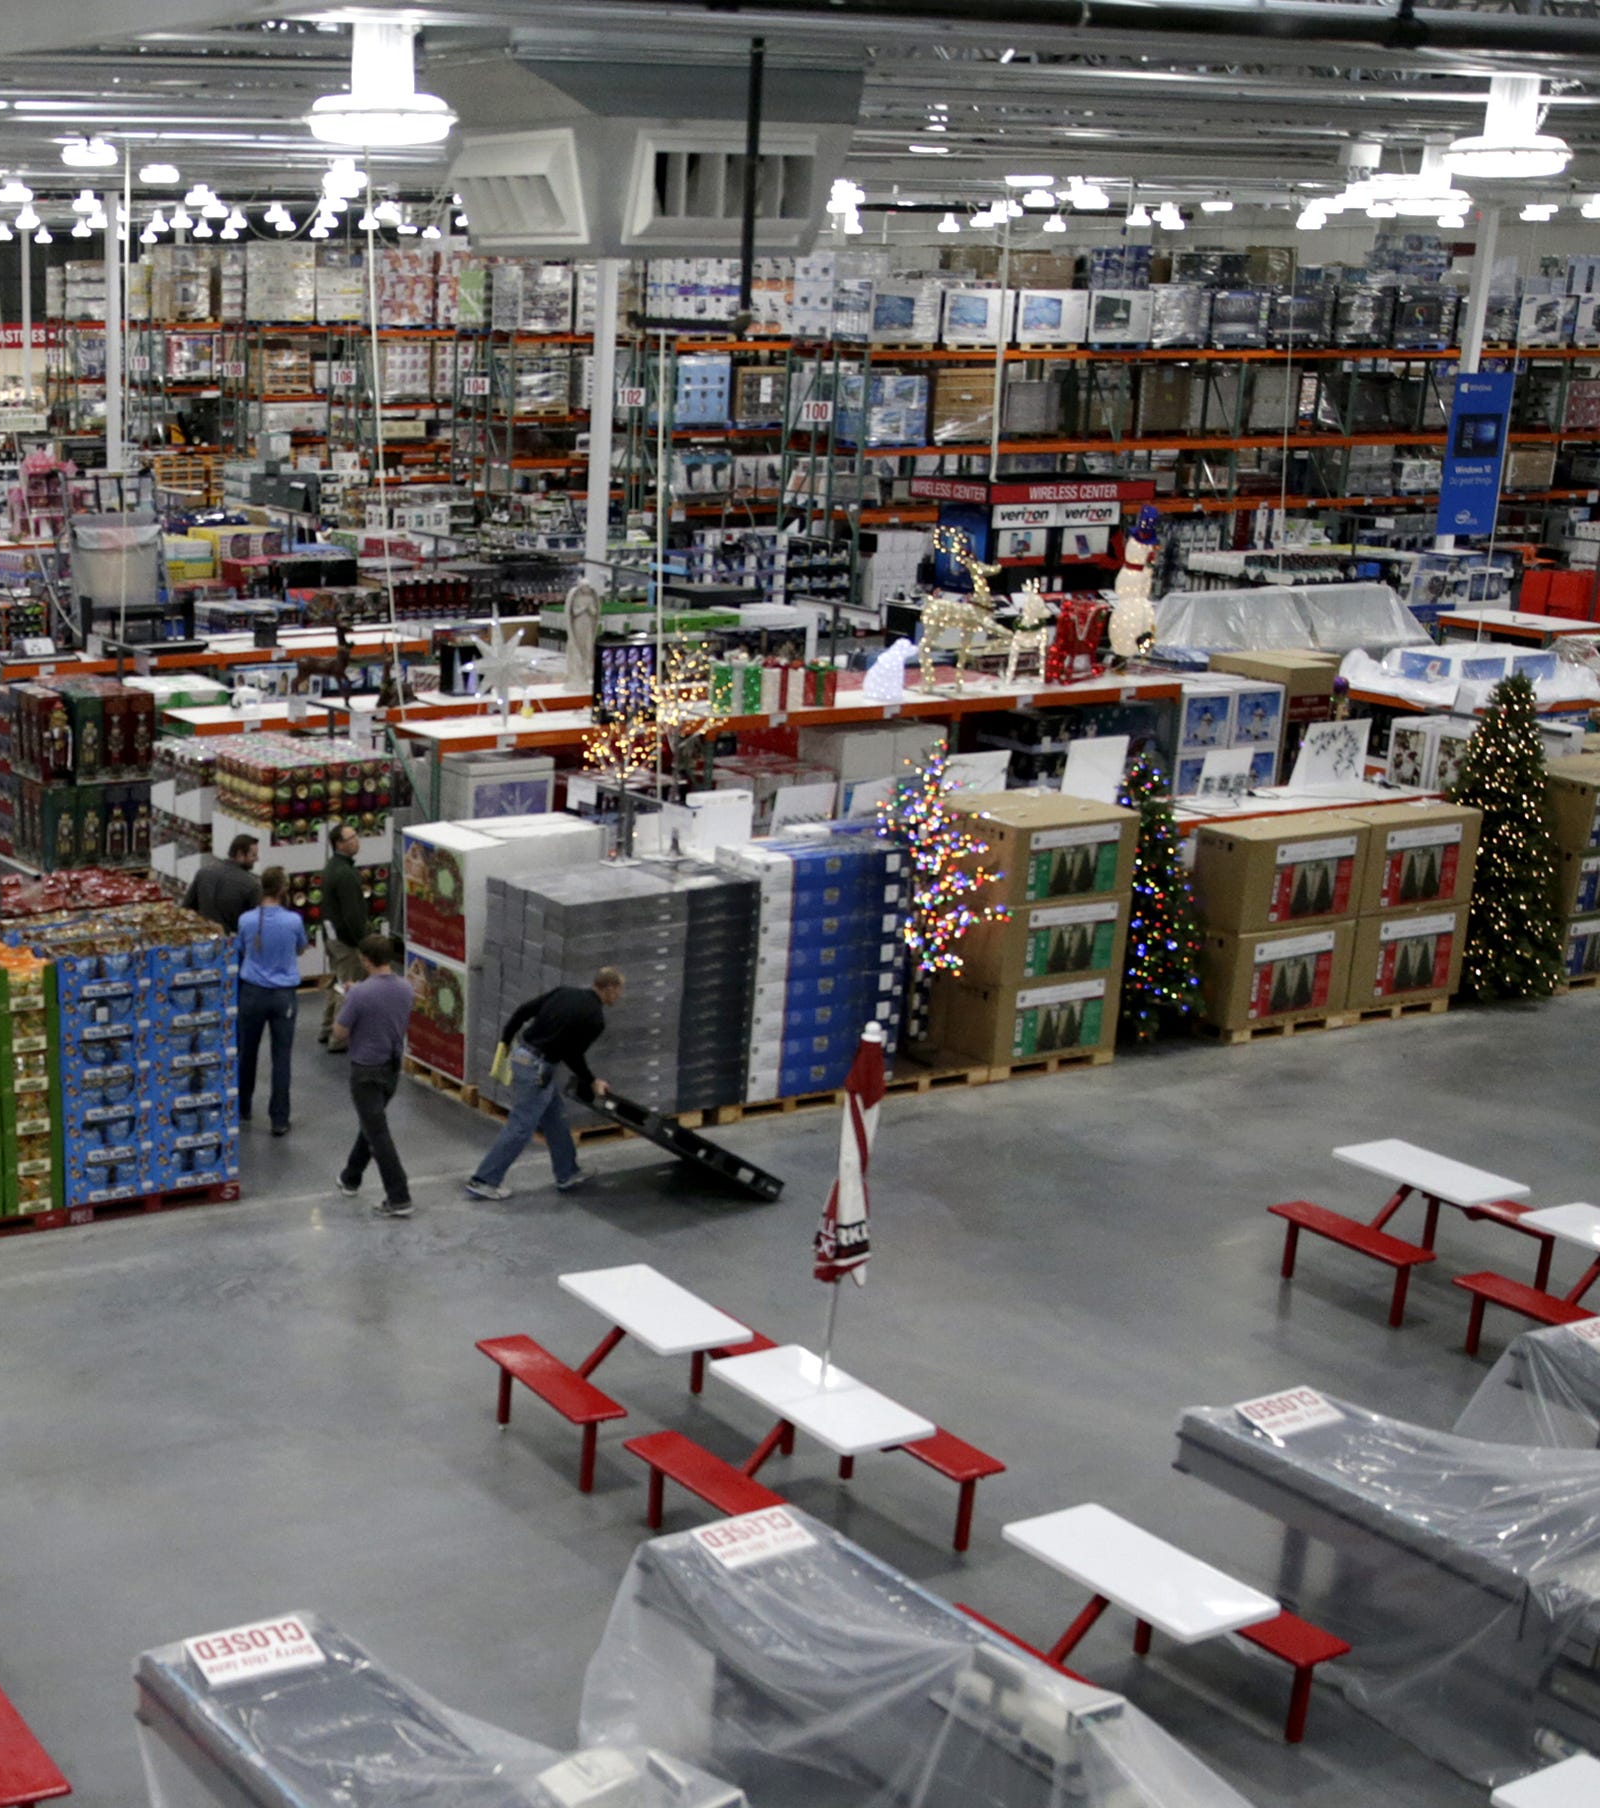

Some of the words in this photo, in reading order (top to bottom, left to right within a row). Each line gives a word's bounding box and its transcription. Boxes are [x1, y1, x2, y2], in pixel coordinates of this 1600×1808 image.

[466, 379, 486, 394] 104
[619, 390, 641, 404] 102
[804, 403, 828, 419] 100
[910, 479, 950, 496] WIRELESS
[952, 484, 987, 500] CENTER
[1029, 485, 1078, 500] WIRELESS
[1080, 483, 1118, 499] CENTER
[1000, 507, 1049, 524] verizon
[1065, 504, 1113, 522] verizon
[1243, 1390, 1320, 1421] CLOSED
[700, 1511, 793, 1549] CLOSED
[193, 1621, 305, 1661] CLOSED
